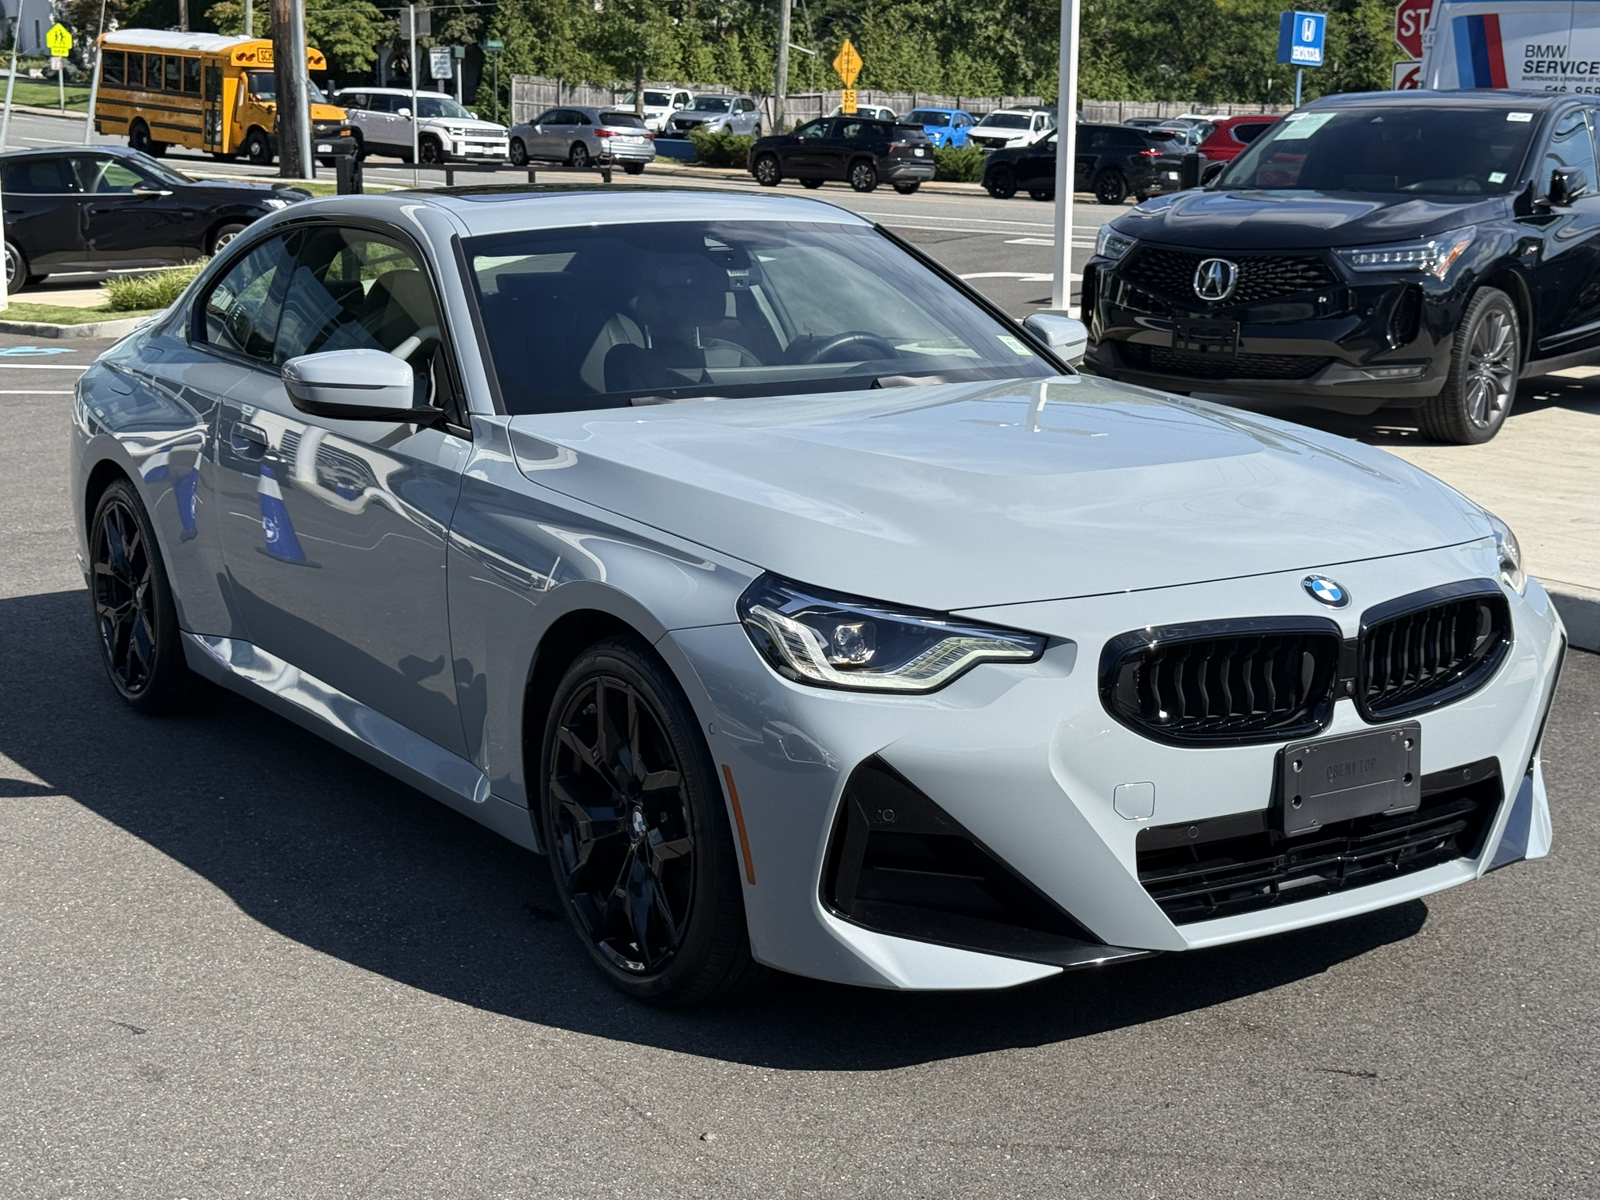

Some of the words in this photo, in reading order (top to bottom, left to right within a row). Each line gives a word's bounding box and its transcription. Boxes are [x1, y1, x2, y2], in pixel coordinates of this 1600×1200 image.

[1400, 9, 1430, 37] ST
[1525, 44, 1567, 58] BMW
[1523, 60, 1600, 74] SERVICE
[844, 92, 855, 103] 35
[1359, 757, 1377, 773] TOP
